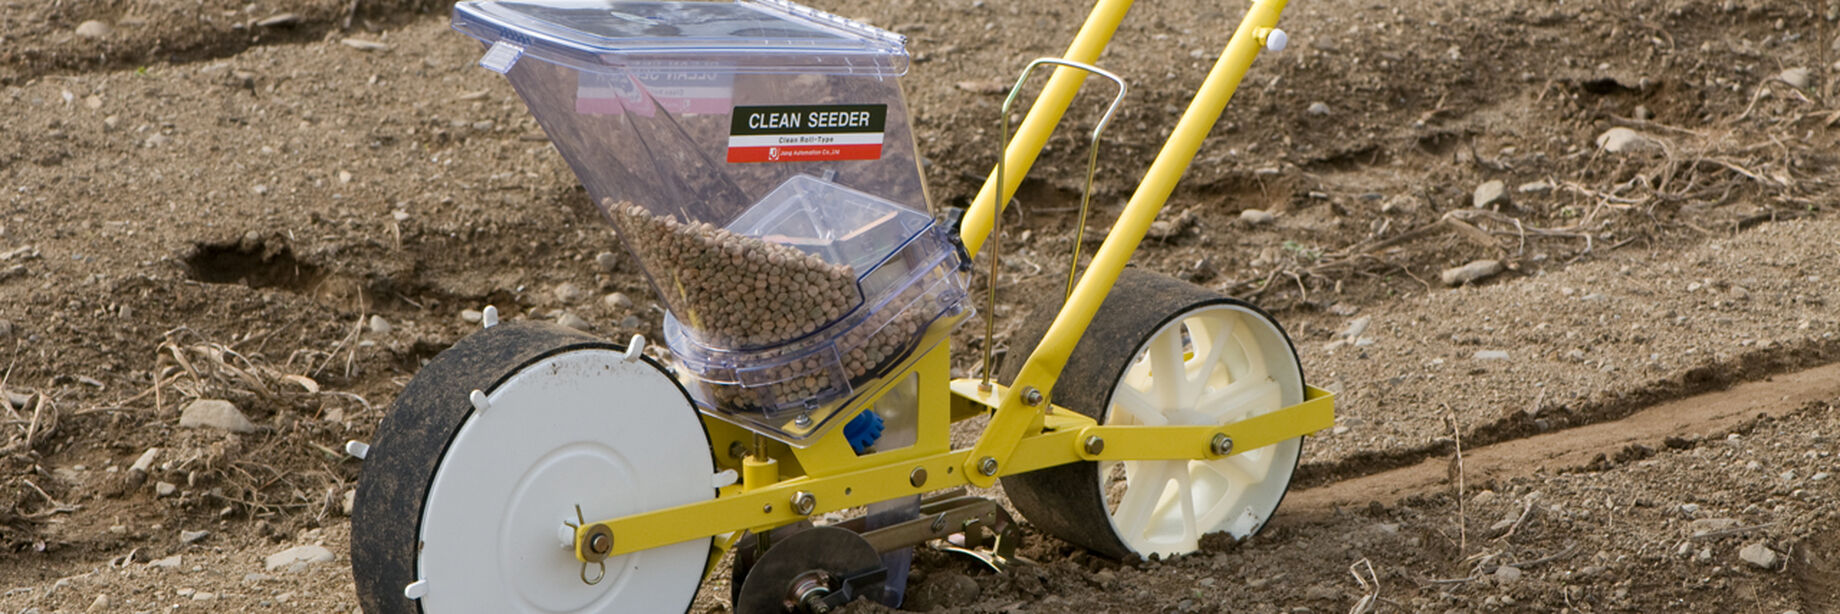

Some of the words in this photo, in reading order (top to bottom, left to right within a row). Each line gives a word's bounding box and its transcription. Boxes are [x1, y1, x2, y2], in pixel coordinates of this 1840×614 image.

[749, 112, 801, 129] CLEAN
[808, 111, 870, 128] SEEDER
[779, 136, 798, 144] Clean
[800, 135, 834, 143] Roll-Type
